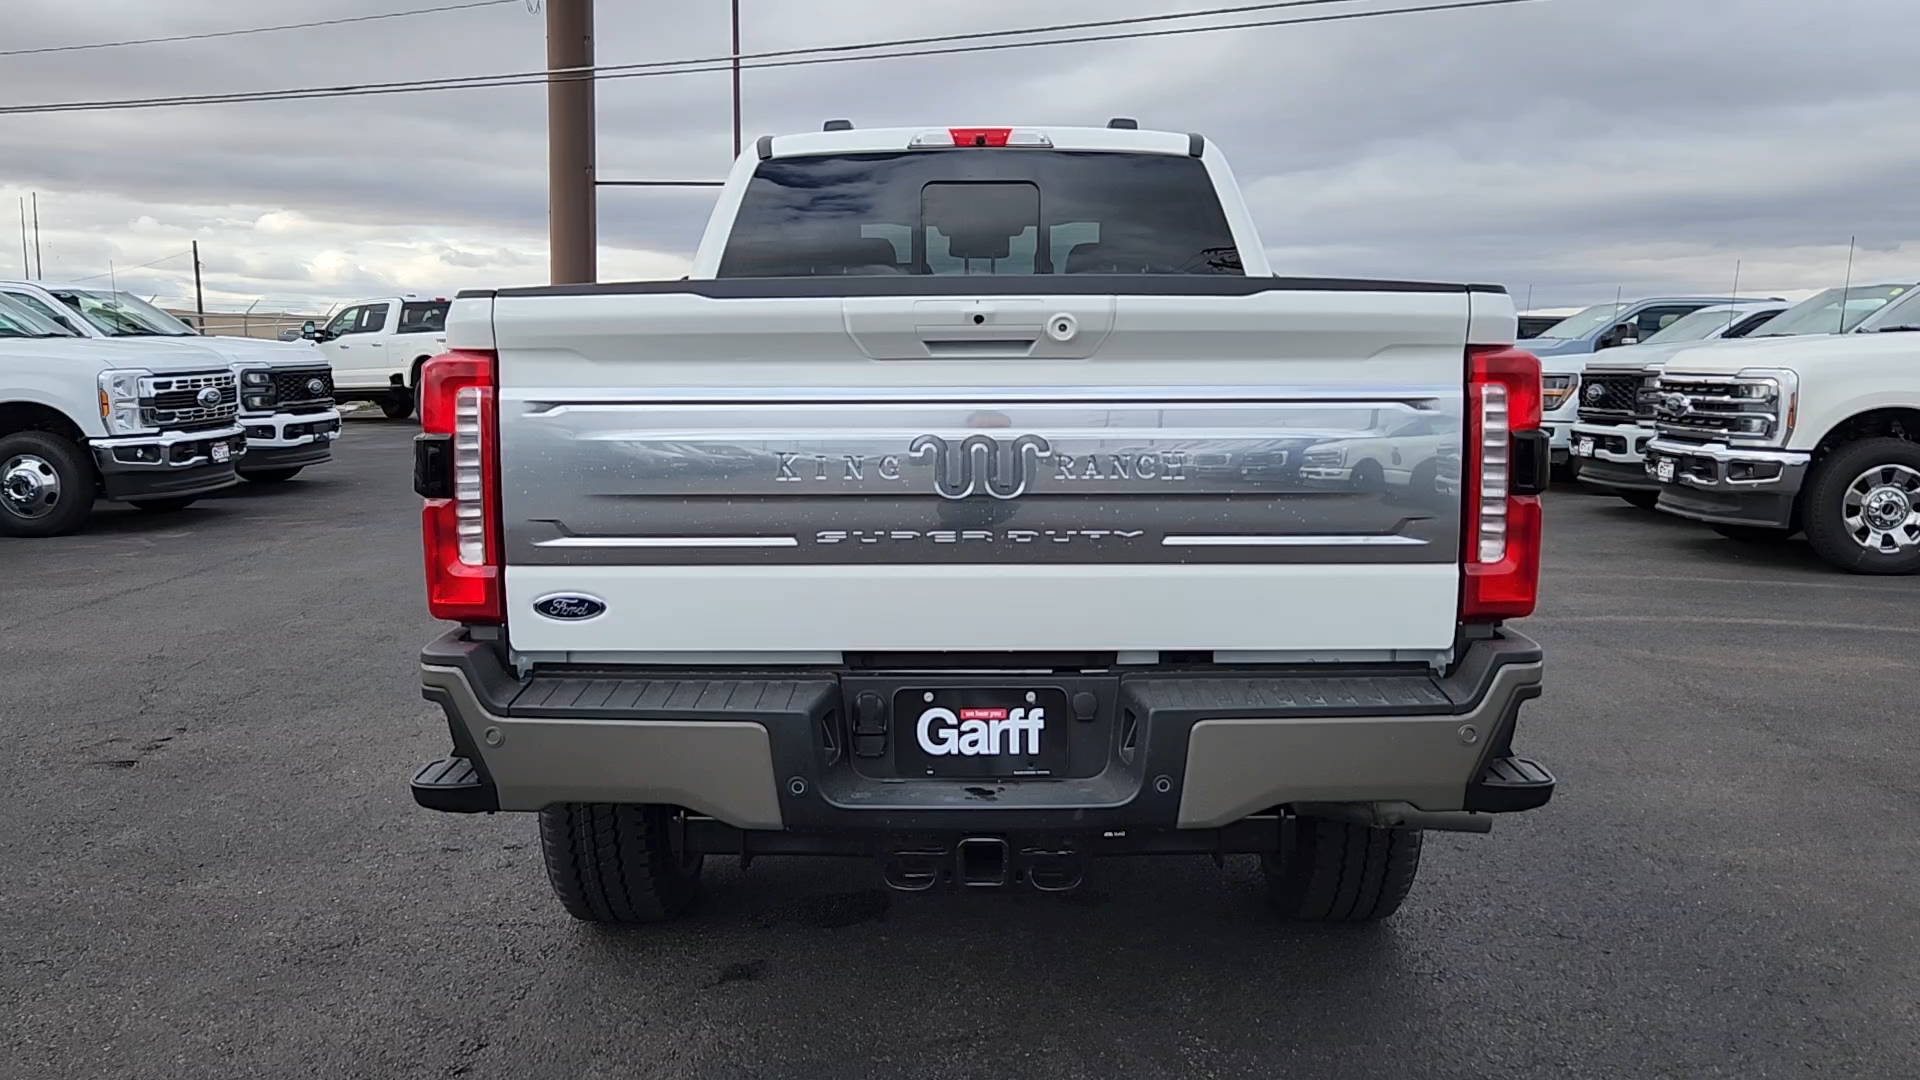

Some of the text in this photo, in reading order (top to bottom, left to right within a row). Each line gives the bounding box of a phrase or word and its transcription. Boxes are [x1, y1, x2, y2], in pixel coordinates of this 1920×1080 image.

[773, 452, 901, 482] KING
[1053, 451, 1187, 481] RANCH
[815, 530, 1144, 543] SUPER DUTY
[549, 598, 589, 616] Ford
[916, 707, 1045, 756] Garff
